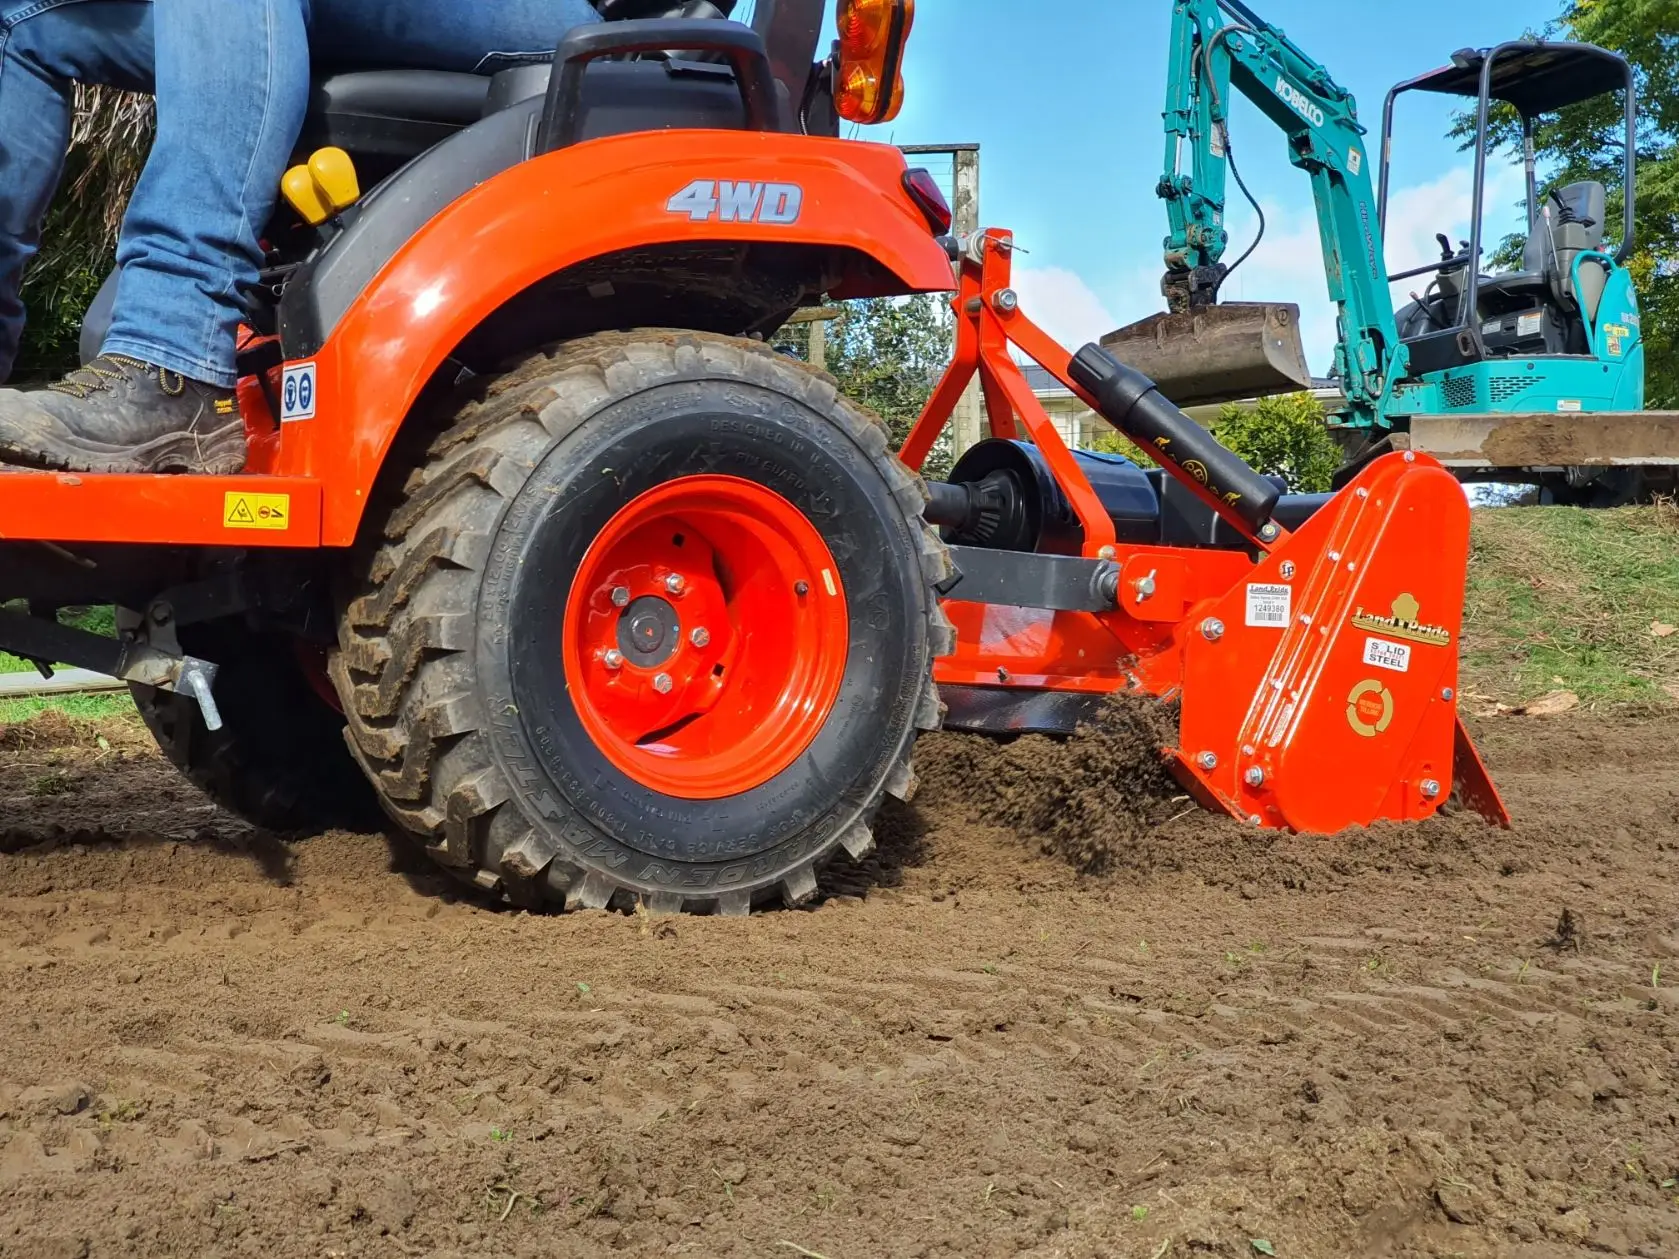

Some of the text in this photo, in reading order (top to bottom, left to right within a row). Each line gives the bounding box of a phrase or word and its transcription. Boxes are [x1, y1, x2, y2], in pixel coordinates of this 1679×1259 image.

[1275, 76, 1324, 127] KOBELCO
[666, 179, 803, 224] 4WD
[1355, 605, 1450, 637] Land Pride
[1369, 653, 1403, 668] STEEL
[483, 688, 844, 888] GARDEN MASTER
